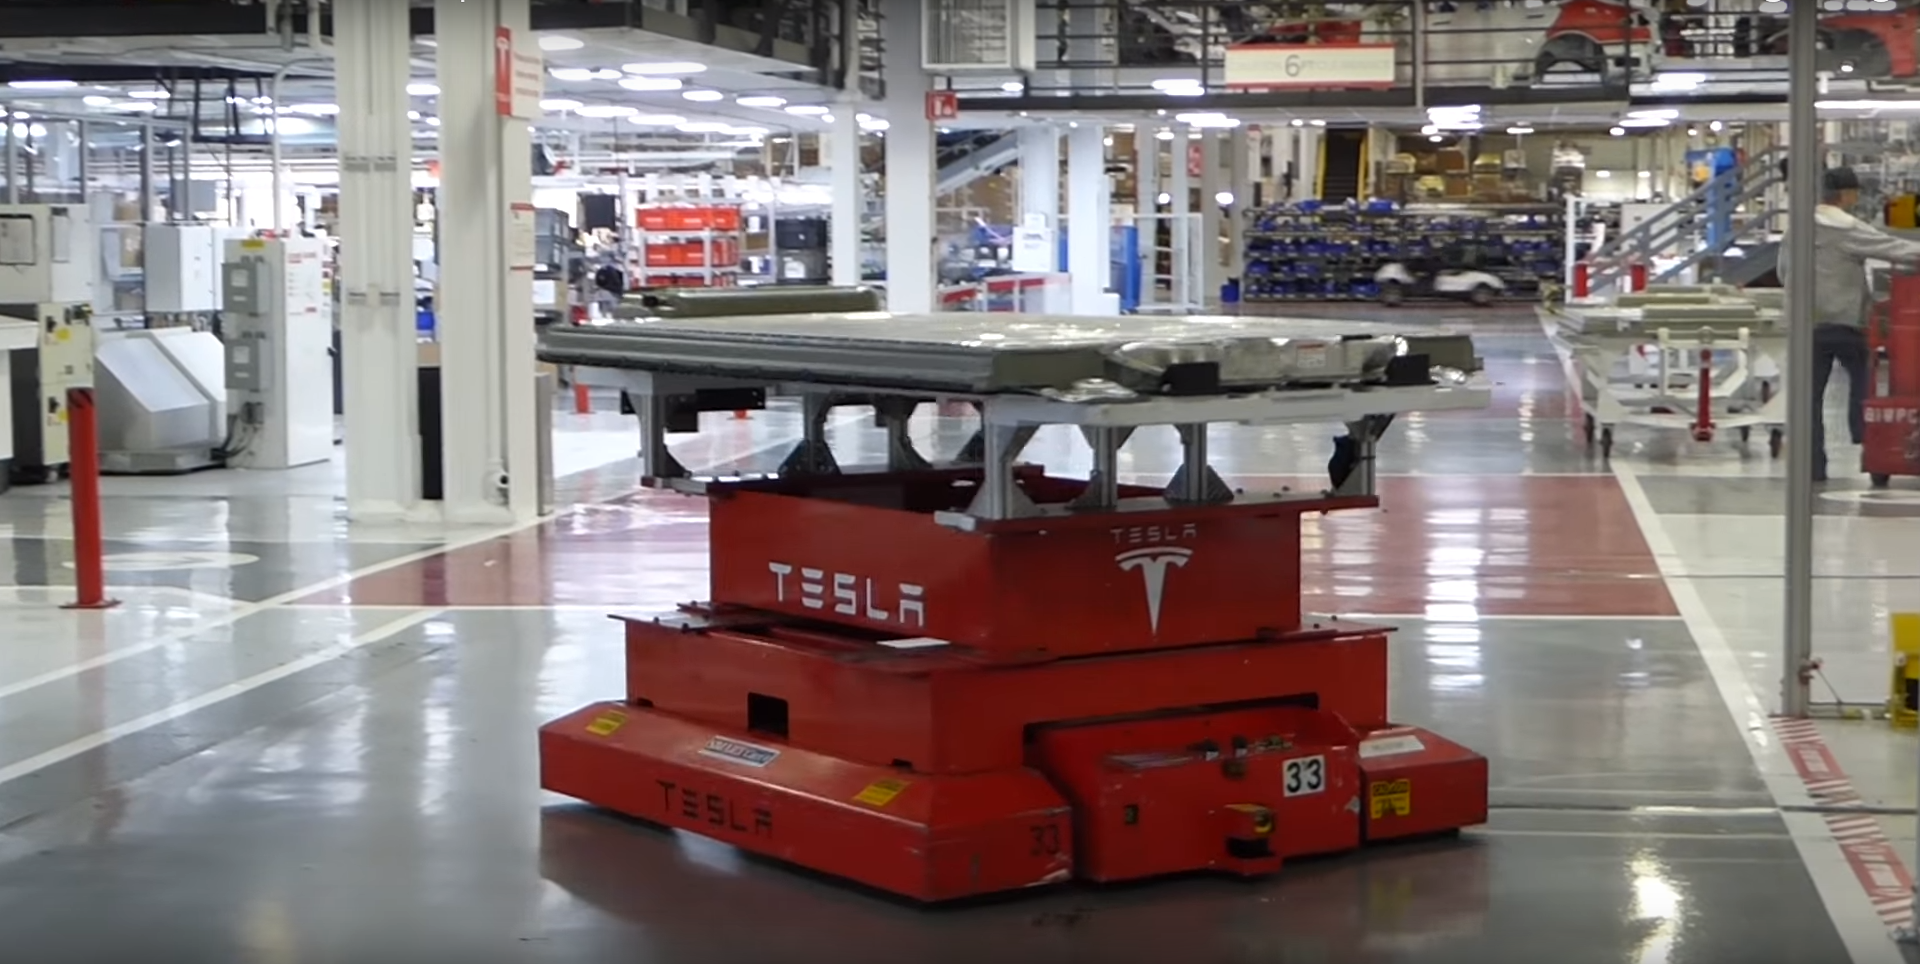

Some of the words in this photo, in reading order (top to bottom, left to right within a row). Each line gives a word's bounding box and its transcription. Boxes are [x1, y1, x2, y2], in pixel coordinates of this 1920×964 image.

[1110, 523, 1197, 544] TESLA
[768, 561, 923, 627] TESLA
[1286, 758, 1321, 793] 33
[656, 779, 772, 839] TESLA
[1029, 824, 1060, 857] 33
